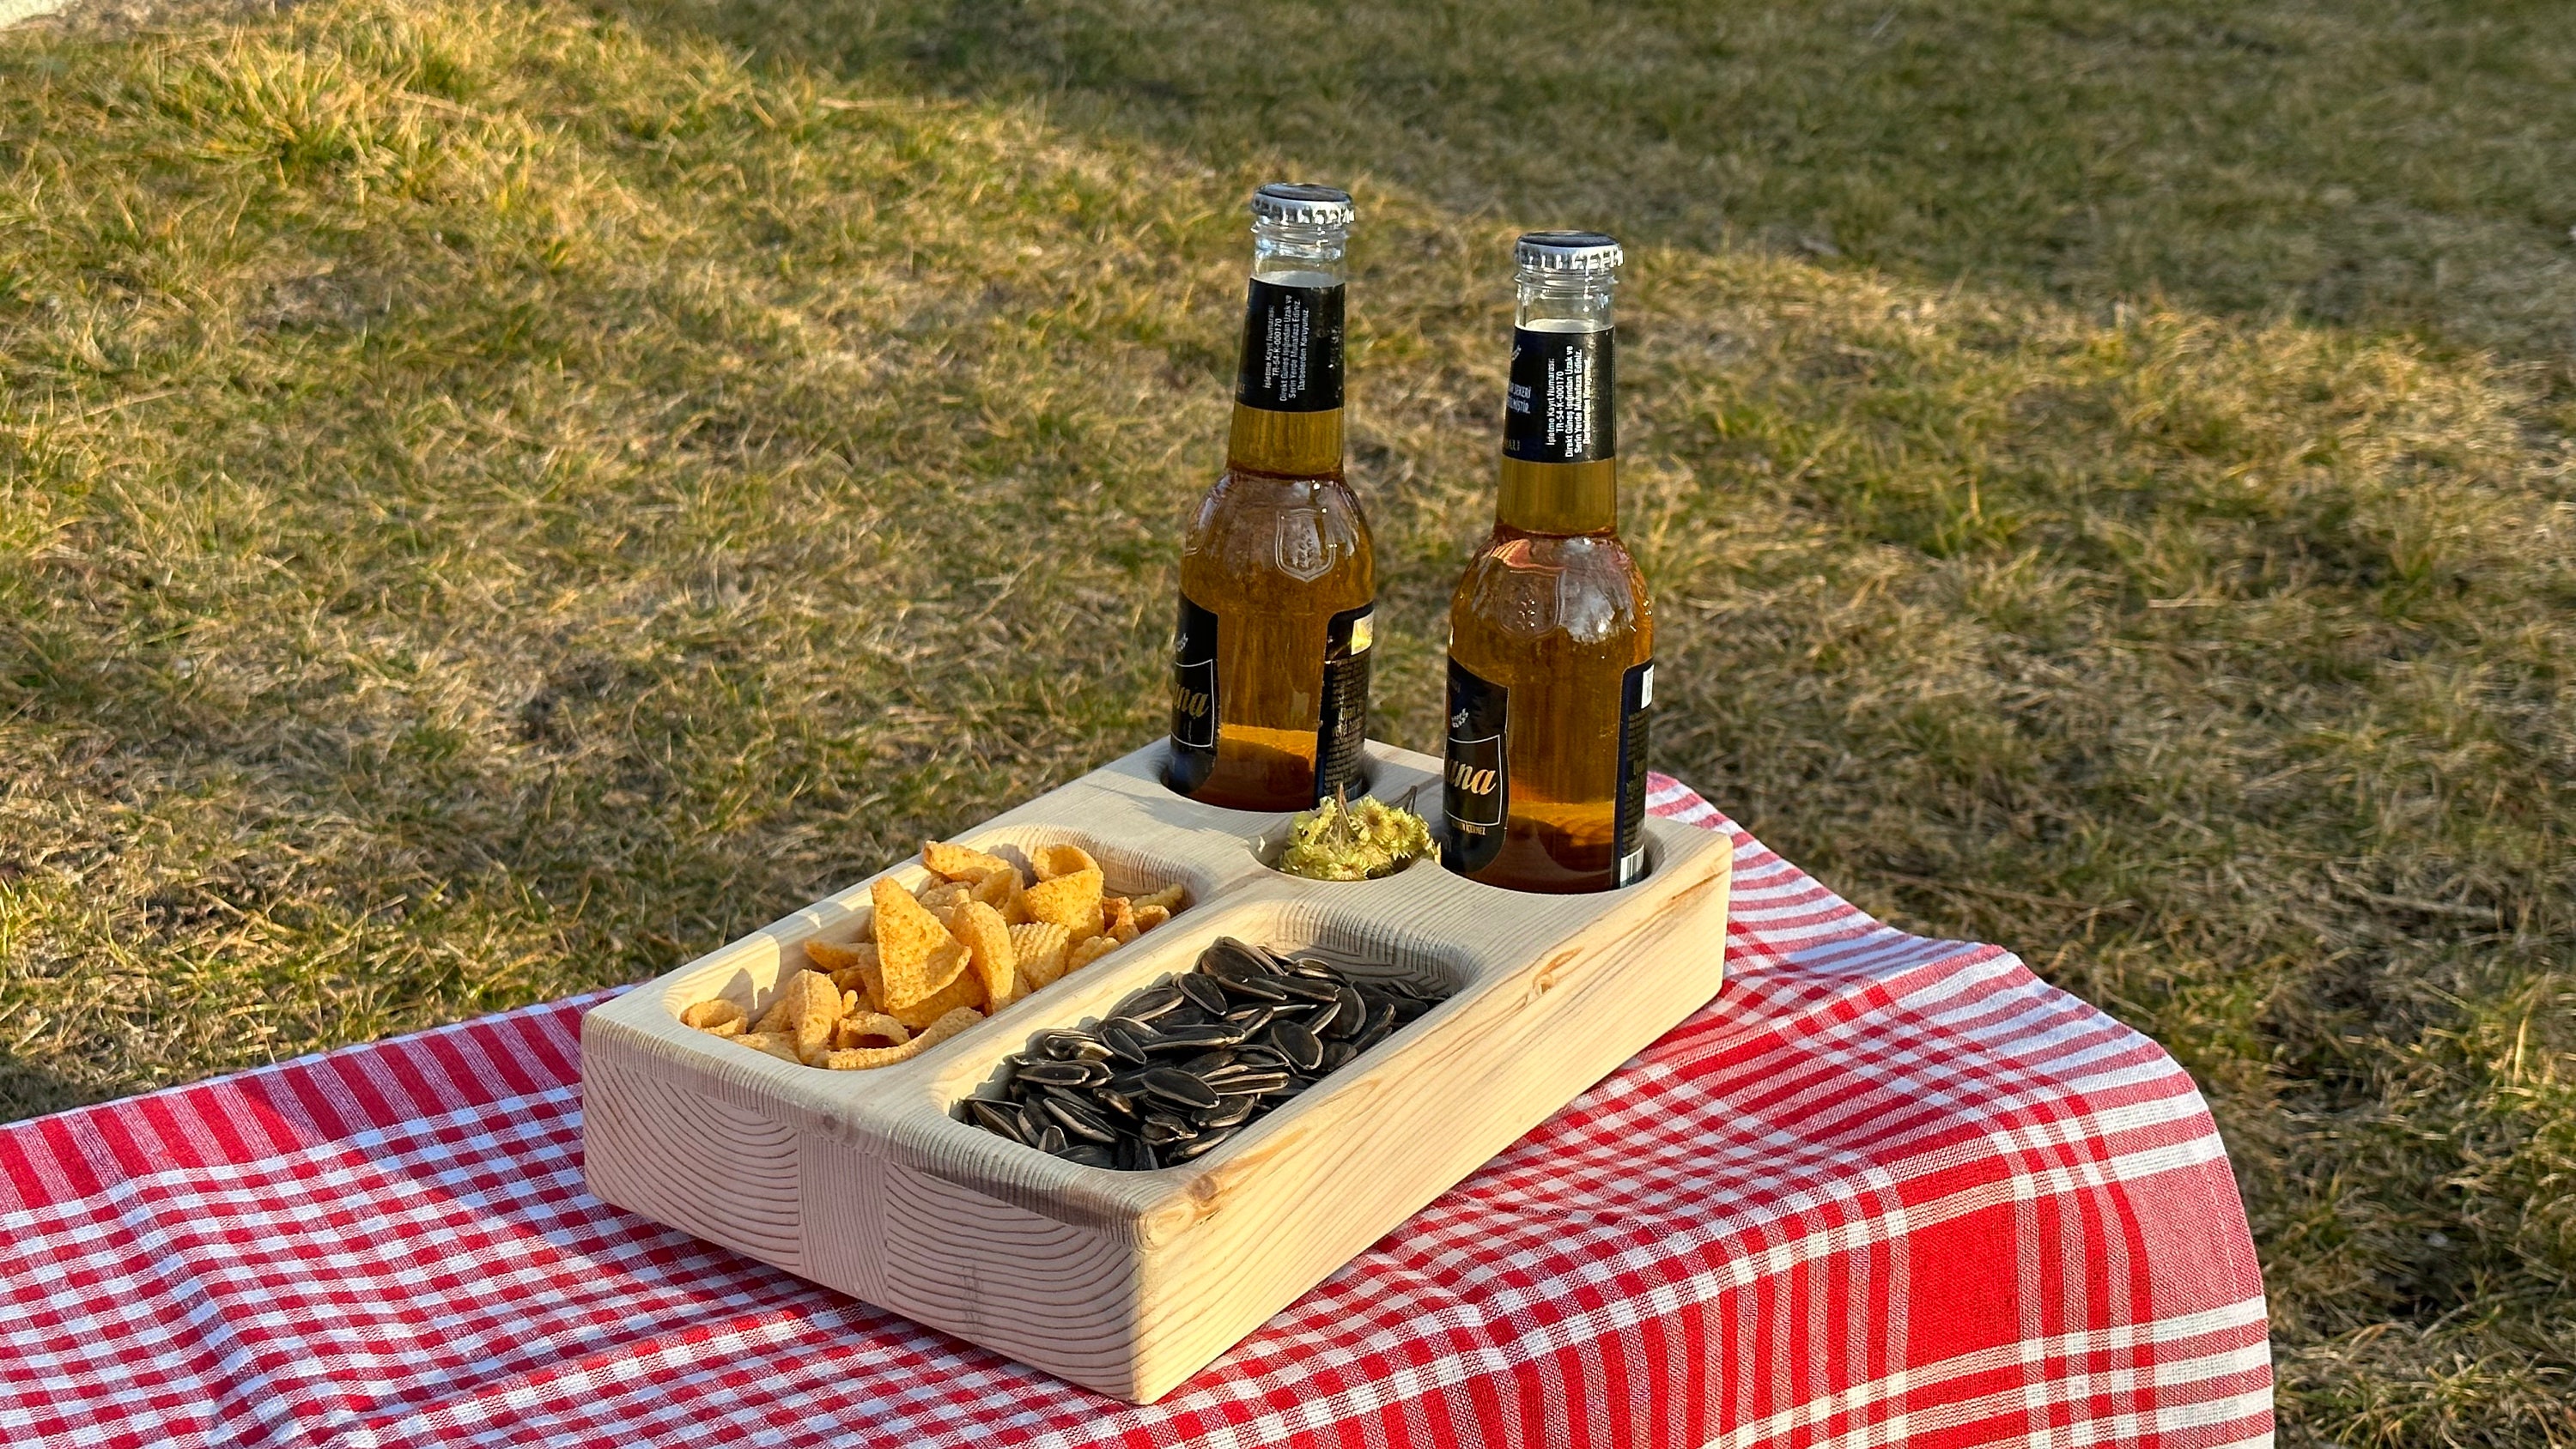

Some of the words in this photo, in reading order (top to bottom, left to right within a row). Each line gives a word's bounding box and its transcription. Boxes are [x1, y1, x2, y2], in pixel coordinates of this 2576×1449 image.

[1285, 294, 1292, 304] ve
[1265, 343, 1273, 361] Kayıt
[1291, 324, 1299, 358] Muhafaza
[1566, 345, 1574, 355] ve
[1281, 357, 1290, 379] Güneş
[1297, 348, 1307, 391] Darbelerden
[1279, 379, 1288, 401] Direkt
[1288, 379, 1297, 398] Serin
[1574, 373, 1583, 411] Muhafaza
[1546, 397, 1556, 417] Kayıt
[1545, 418, 1556, 446] İşletme
[1565, 410, 1575, 434] Güneş
[1574, 411, 1583, 433] Yerde
[1574, 432, 1583, 453] Serin
